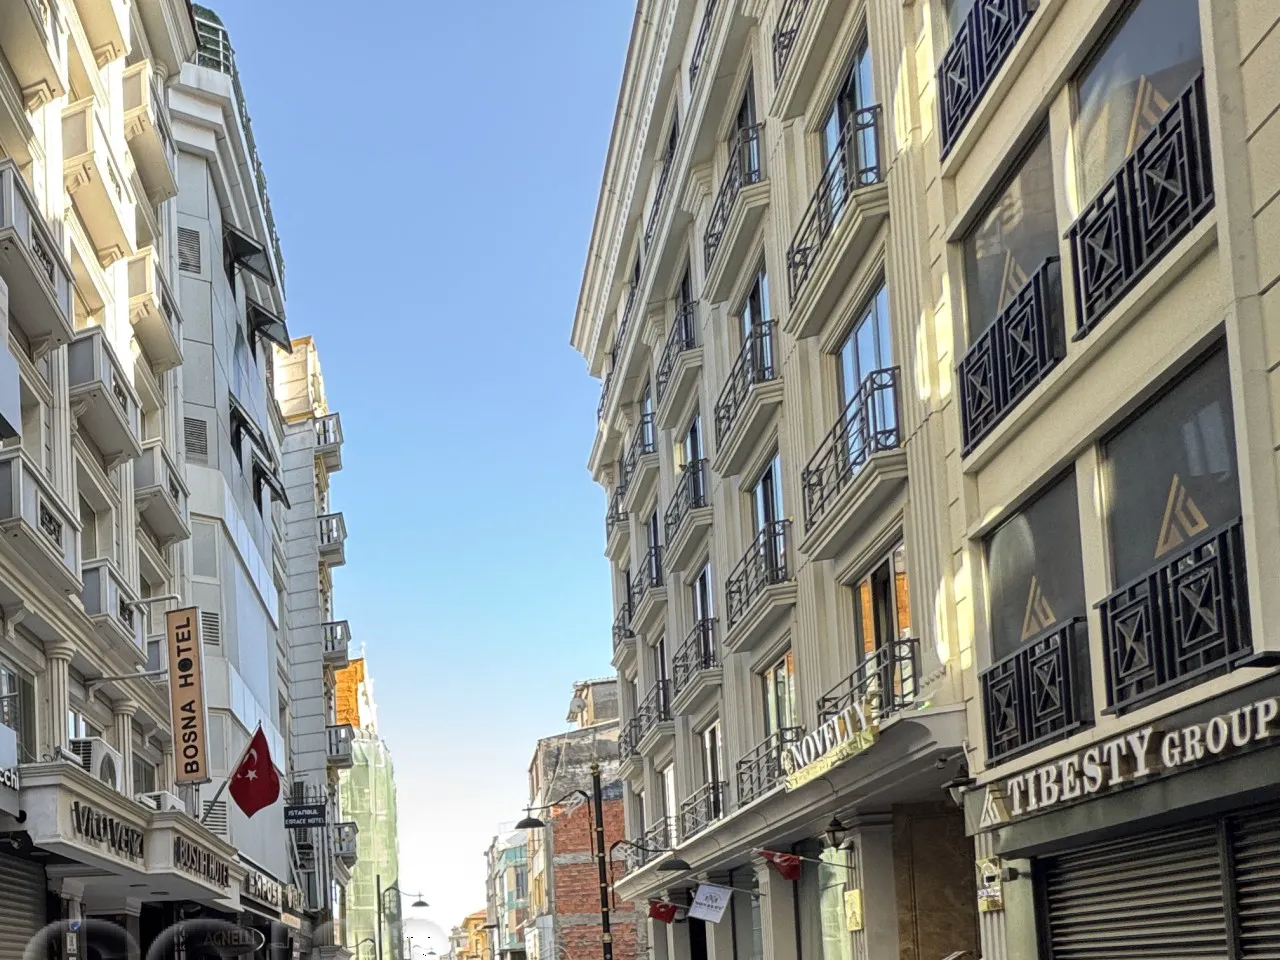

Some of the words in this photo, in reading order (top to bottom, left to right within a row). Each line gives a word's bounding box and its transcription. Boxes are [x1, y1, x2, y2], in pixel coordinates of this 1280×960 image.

[175, 616, 195, 689] HOTEL
[180, 699, 200, 774] BOSNA
[791, 695, 869, 772] NOVELTY
[1007, 725, 1155, 817] TIBESTY
[1161, 697, 1279, 768] GROUP
